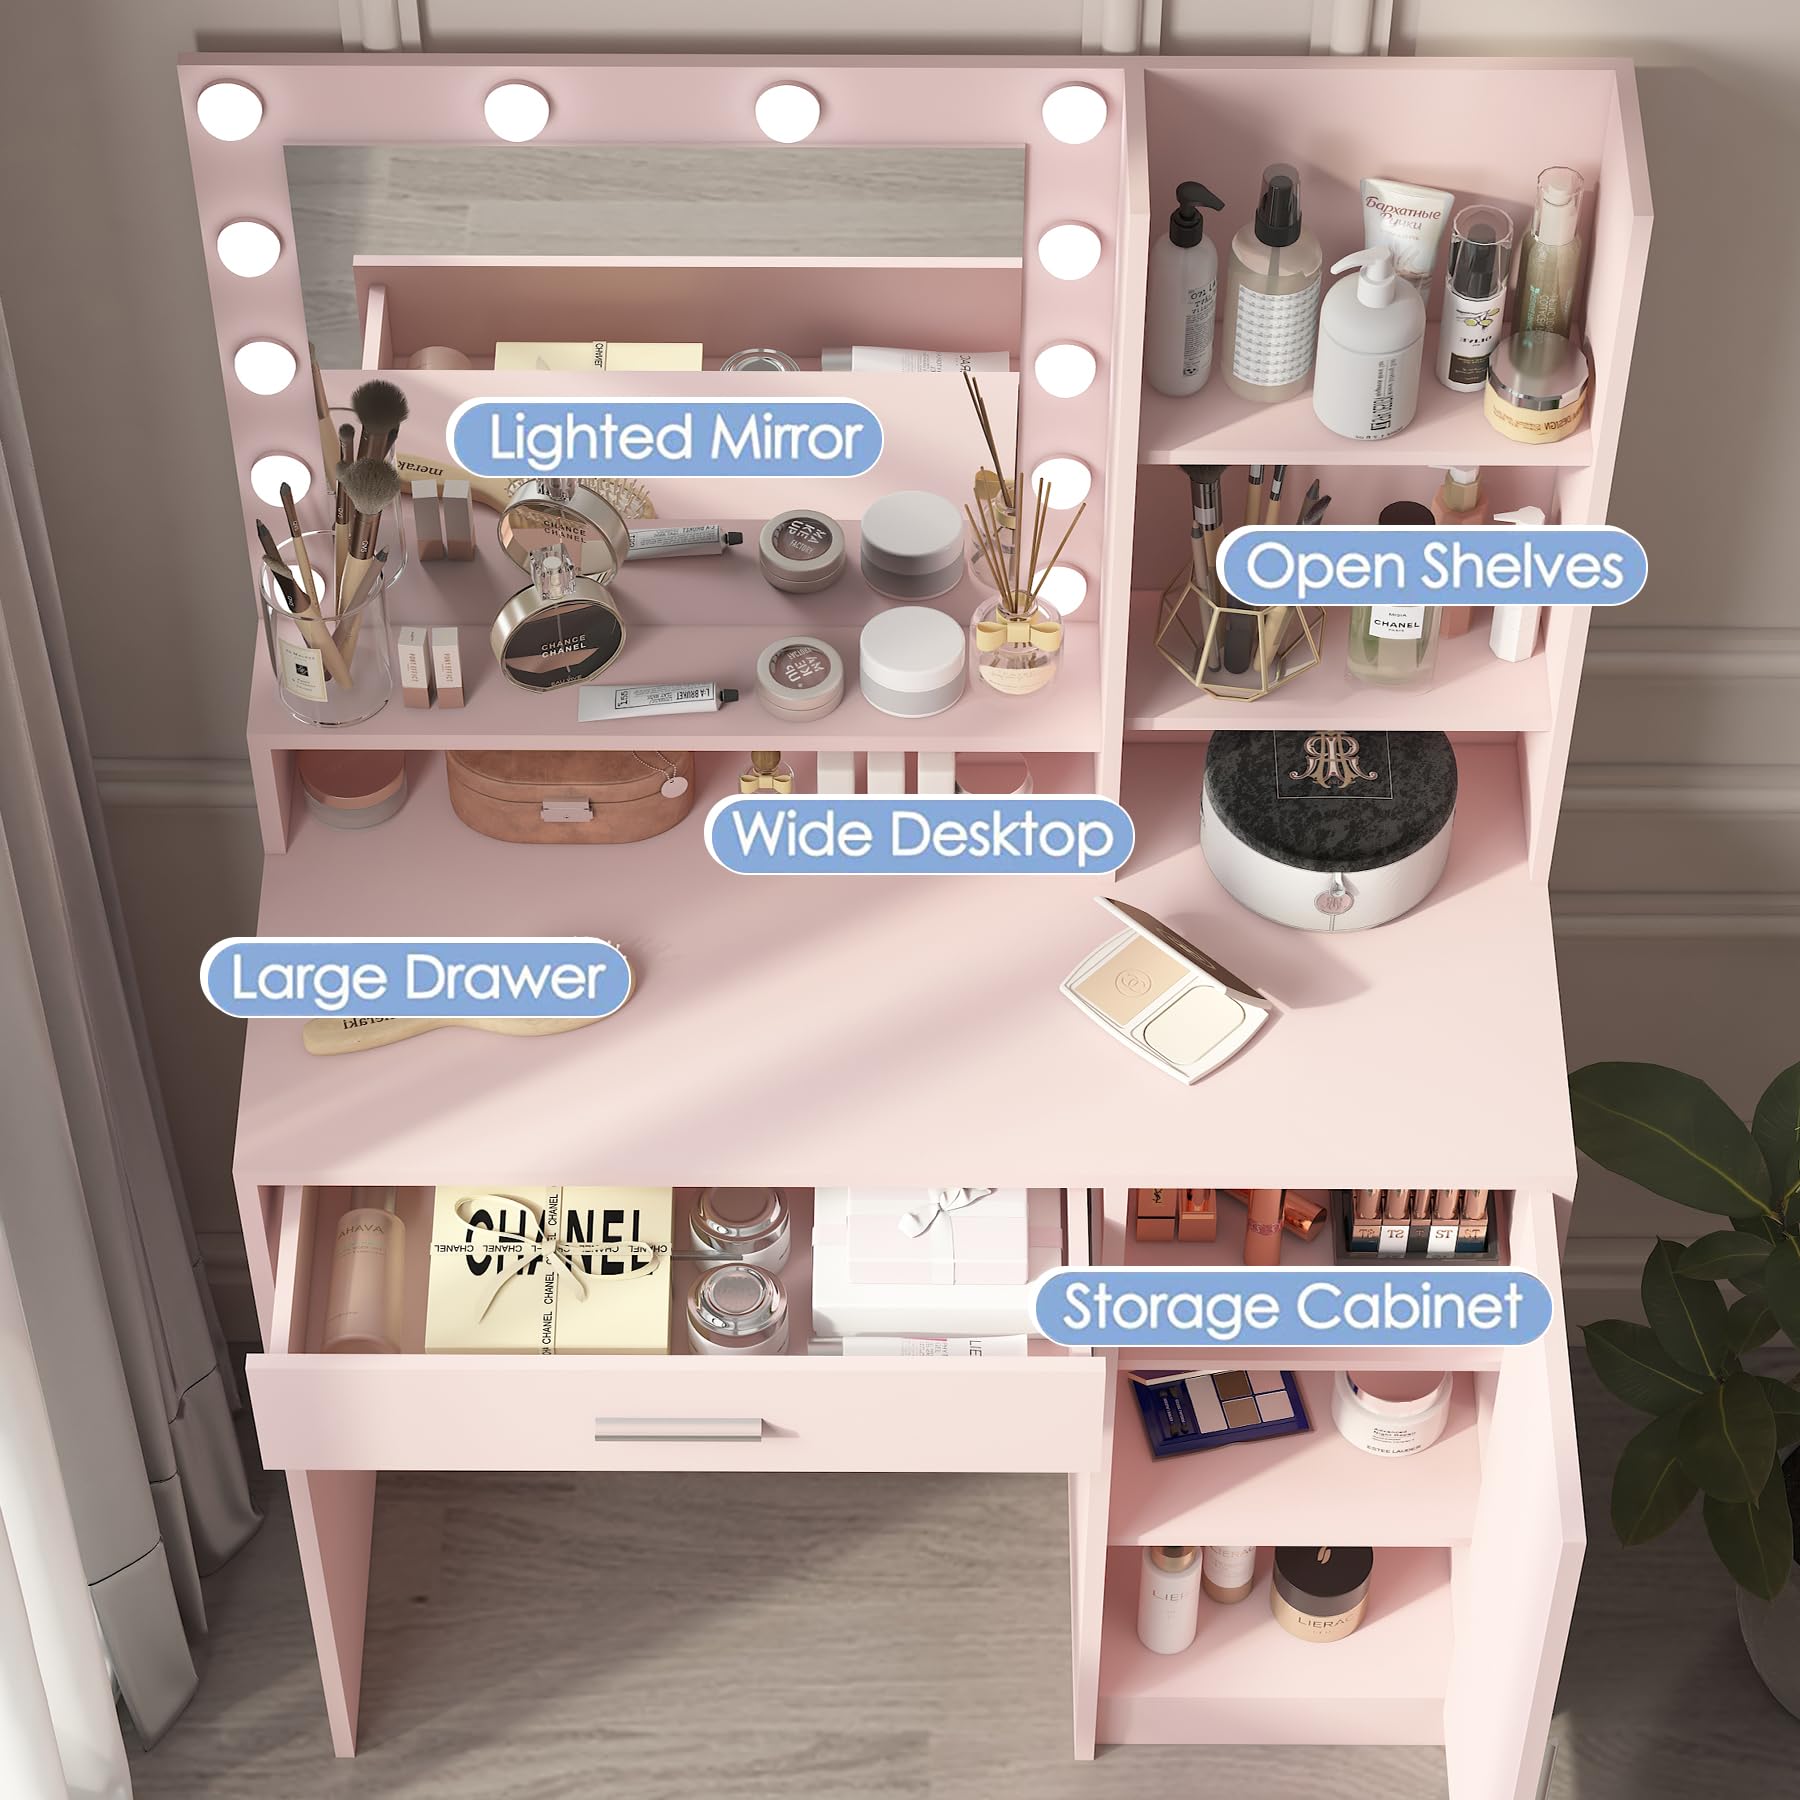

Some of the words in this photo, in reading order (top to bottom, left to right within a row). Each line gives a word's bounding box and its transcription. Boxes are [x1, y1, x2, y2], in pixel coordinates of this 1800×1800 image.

[1365, 196, 1442, 221] Бархатные
[397, 461, 444, 476] merak
[543, 520, 586, 537] CHANCE
[789, 539, 815, 555] FACTORY
[1374, 619, 1420, 629] CHANEL
[541, 634, 587, 652] CHANCE
[541, 642, 587, 659] CHANEL
[547, 1193, 559, 1227] CHANEL
[336, 1223, 385, 1241] AHAVA
[1435, 1229, 1454, 1239] ST
[434, 1244, 475, 1253] CHANEL
[482, 1244, 523, 1253] CHANEL
[543, 1270, 556, 1306] CHANEL
[541, 1310, 554, 1346] CHANEL
